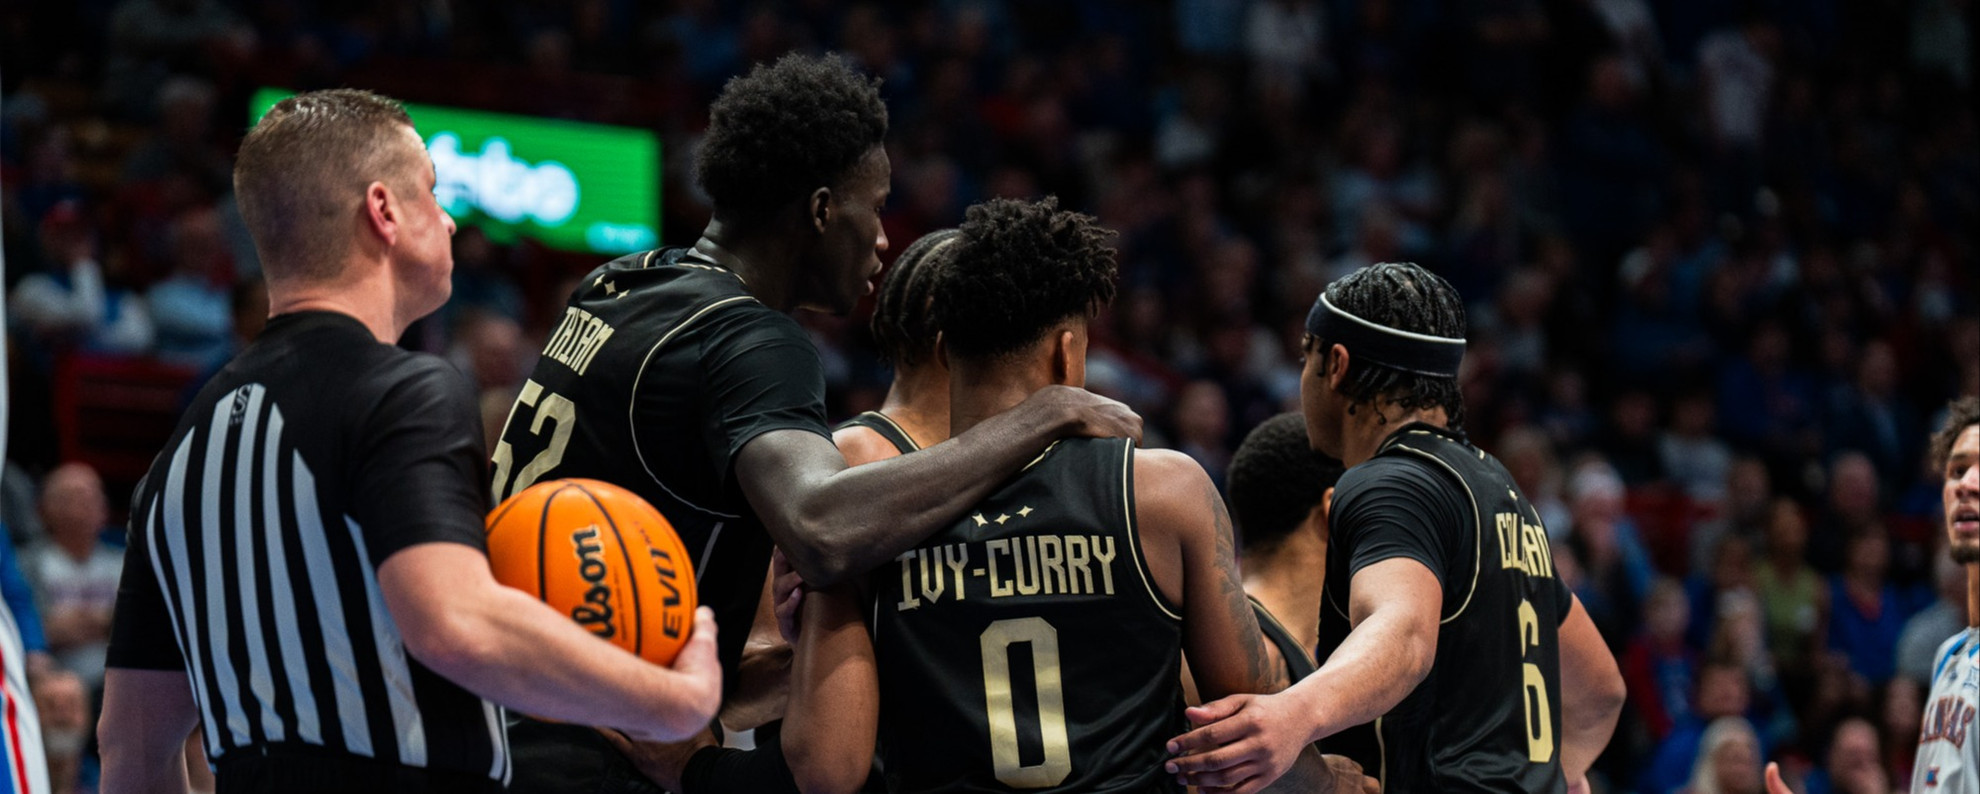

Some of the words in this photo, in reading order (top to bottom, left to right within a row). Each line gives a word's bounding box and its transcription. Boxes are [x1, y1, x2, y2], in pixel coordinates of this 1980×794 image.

[491, 378, 576, 506] 52
[896, 535, 1117, 611] IVY-CURRY
[980, 616, 1072, 789] 0
[1518, 598, 1553, 763] 6
